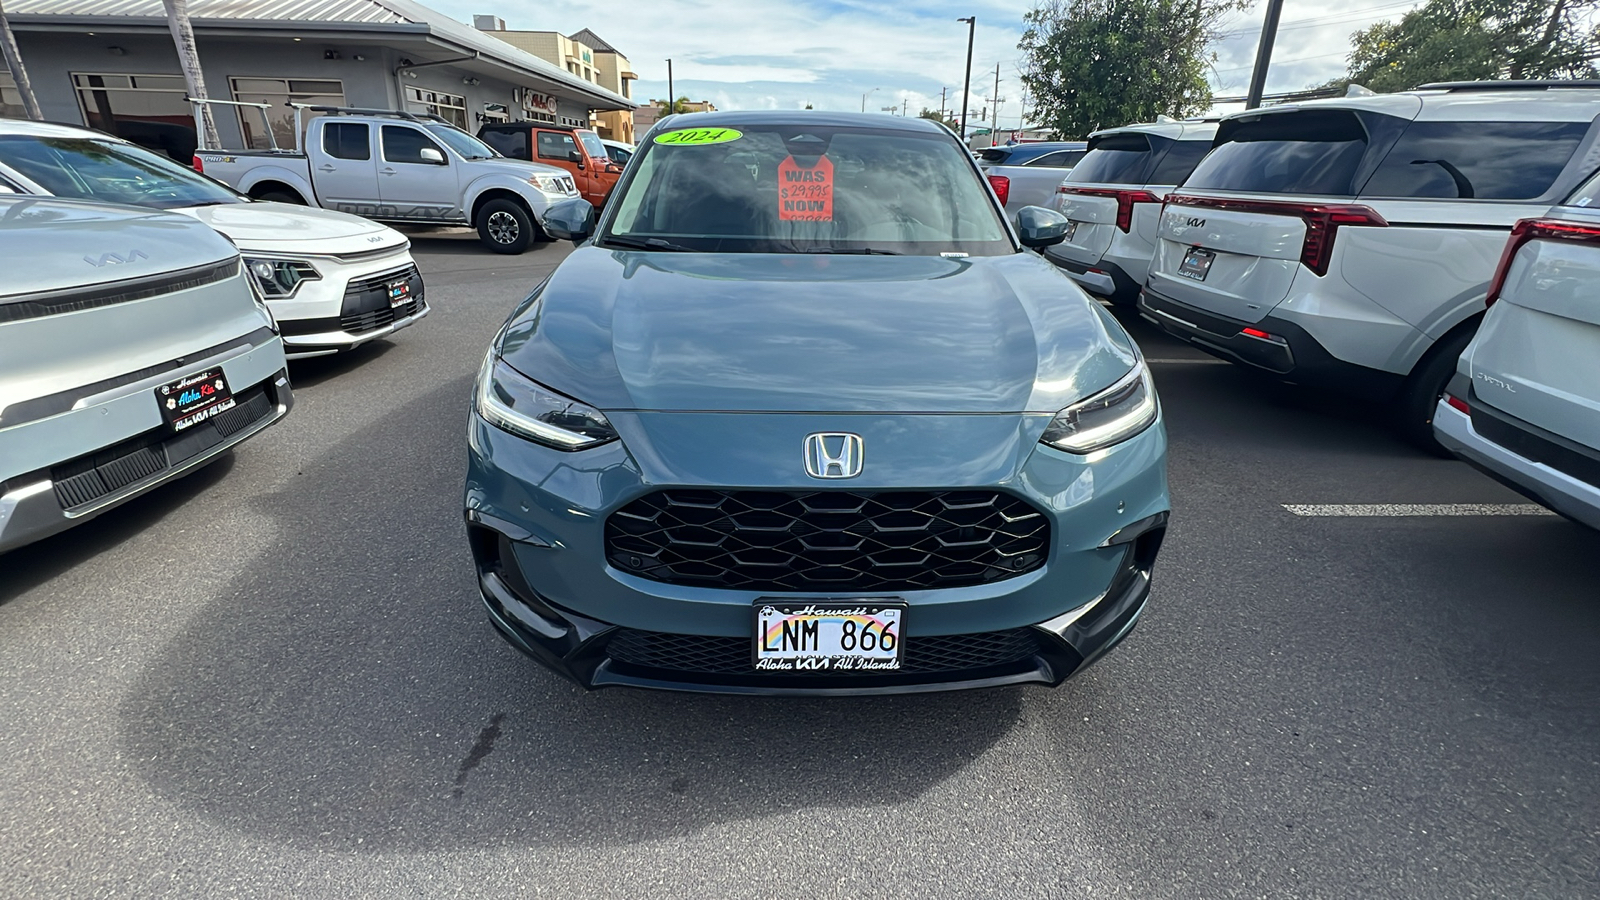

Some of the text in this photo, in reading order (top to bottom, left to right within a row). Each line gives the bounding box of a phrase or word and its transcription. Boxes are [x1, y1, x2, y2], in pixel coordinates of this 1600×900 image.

[664, 130, 728, 143] 2024
[204, 155, 237, 164] PRO-4X
[784, 170, 825, 183] WAS
[784, 200, 825, 212] NOW
[177, 372, 208, 389] Hawaii
[178, 389, 202, 406] Aloha
[200, 384, 215, 397] Kia
[175, 419, 194, 431] Aloha
[792, 605, 868, 617] Hawaii
[762, 620, 896, 652] LNM 866
[755, 657, 901, 670] Aloha KIA All Islands
